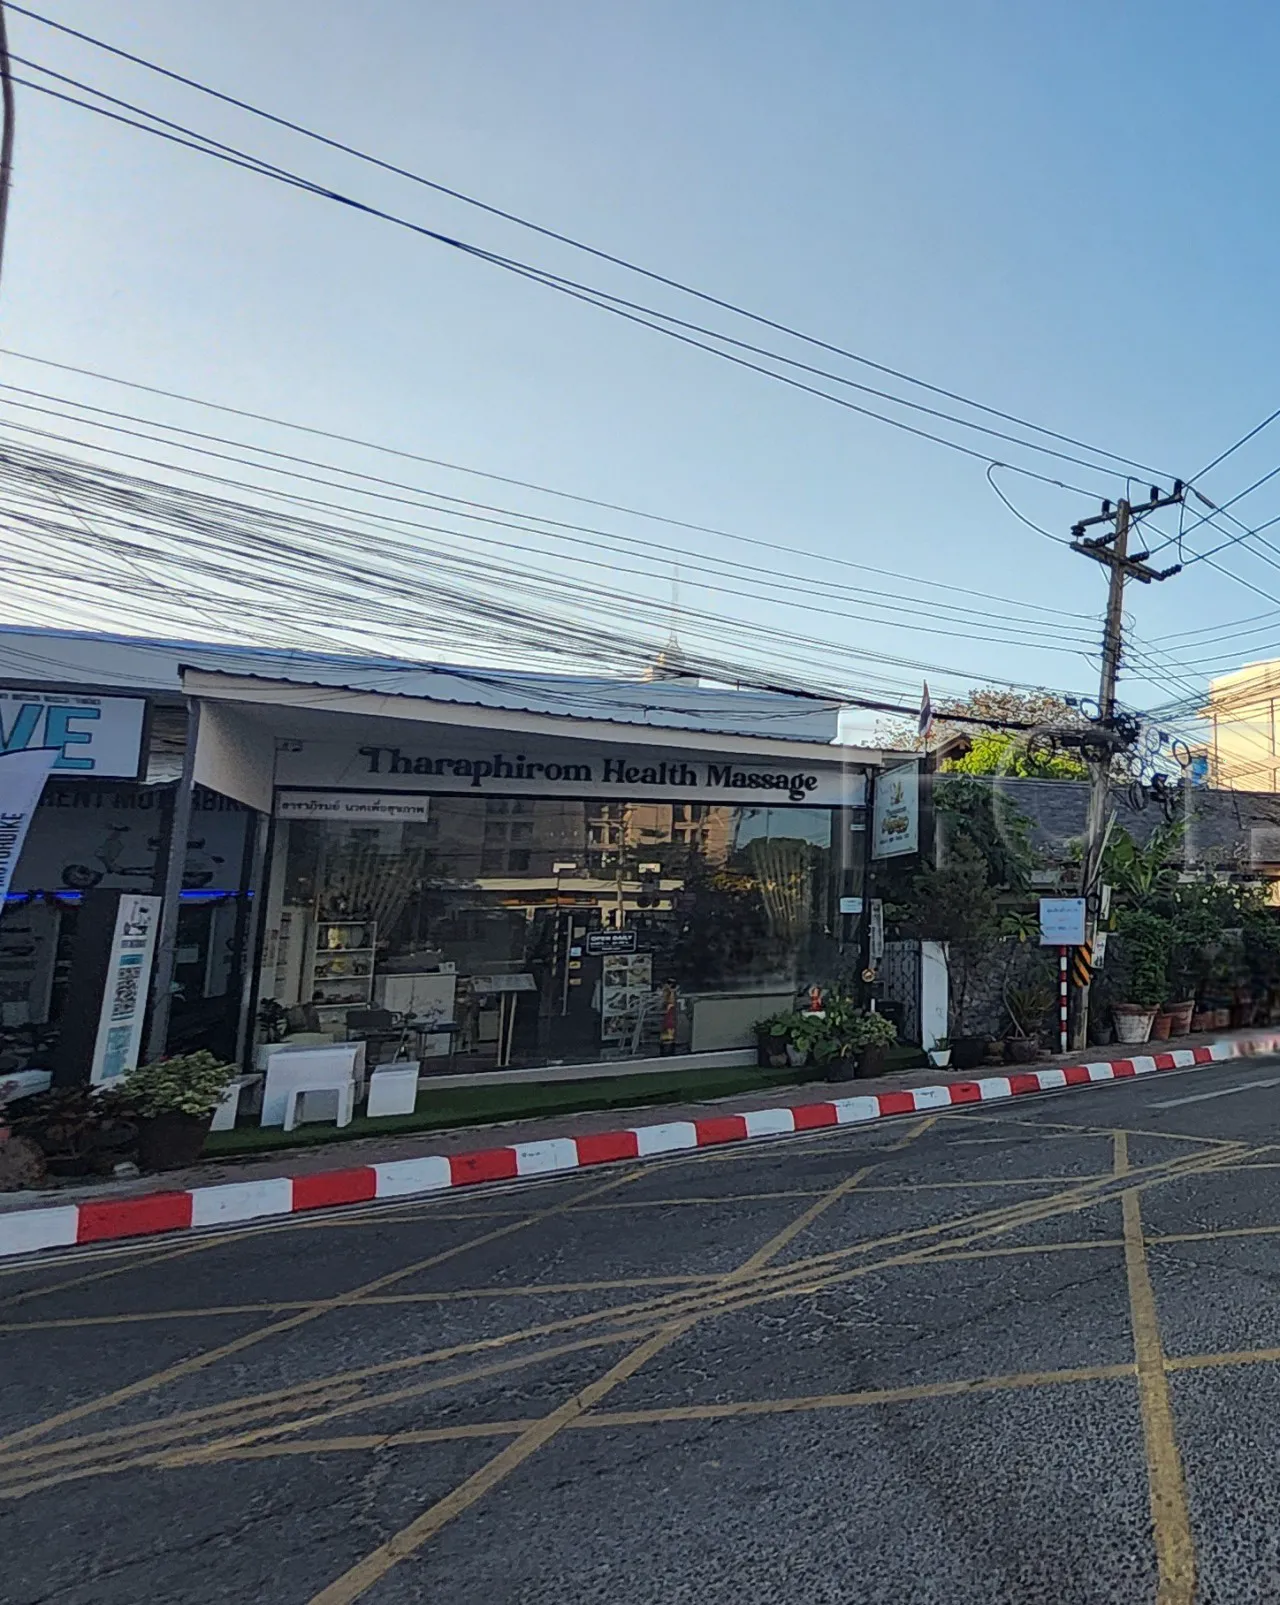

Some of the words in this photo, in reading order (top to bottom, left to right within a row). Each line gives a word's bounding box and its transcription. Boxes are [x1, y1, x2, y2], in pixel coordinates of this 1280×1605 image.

[359, 746, 593, 787] Tharaphirom
[601, 758, 698, 787] Health
[706, 764, 818, 801] Massage
